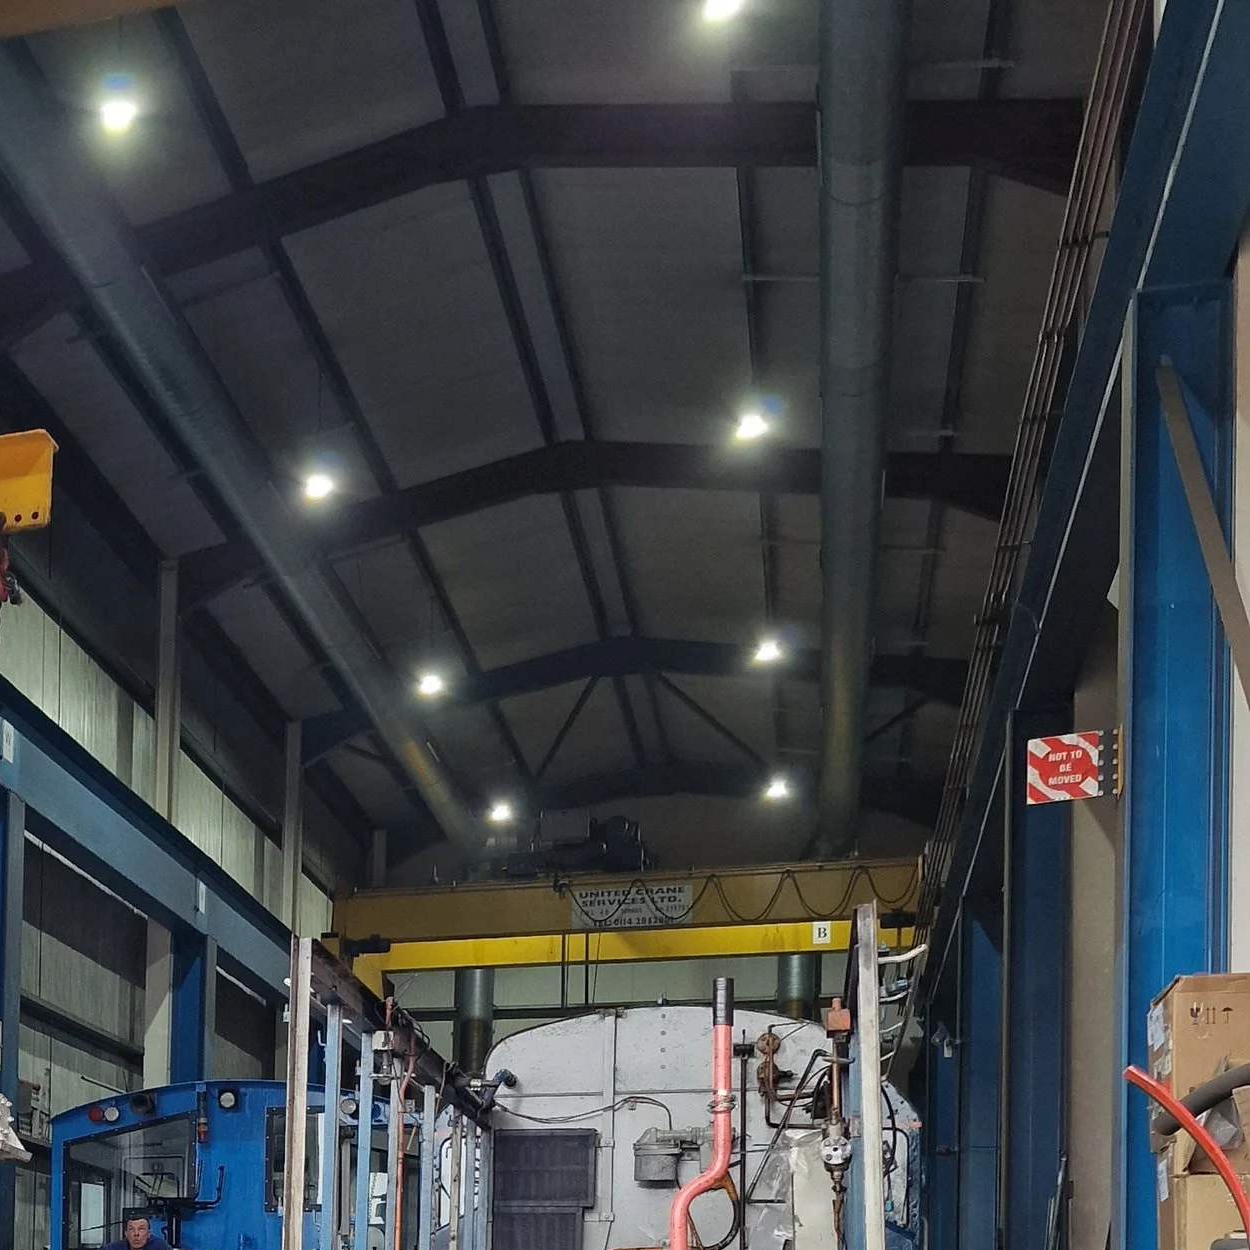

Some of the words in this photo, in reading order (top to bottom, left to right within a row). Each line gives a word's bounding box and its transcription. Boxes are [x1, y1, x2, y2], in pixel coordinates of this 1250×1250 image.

[1048, 752, 1068, 762] NOT
[1070, 749, 1083, 759] TO
[1059, 763, 1072, 773] BE
[1048, 774, 1082, 786] MOVED
[579, 889, 630, 900] UNITED
[636, 886, 685, 896] CRANE
[581, 898, 646, 908] SERVICES
[817, 927, 827, 938] B
